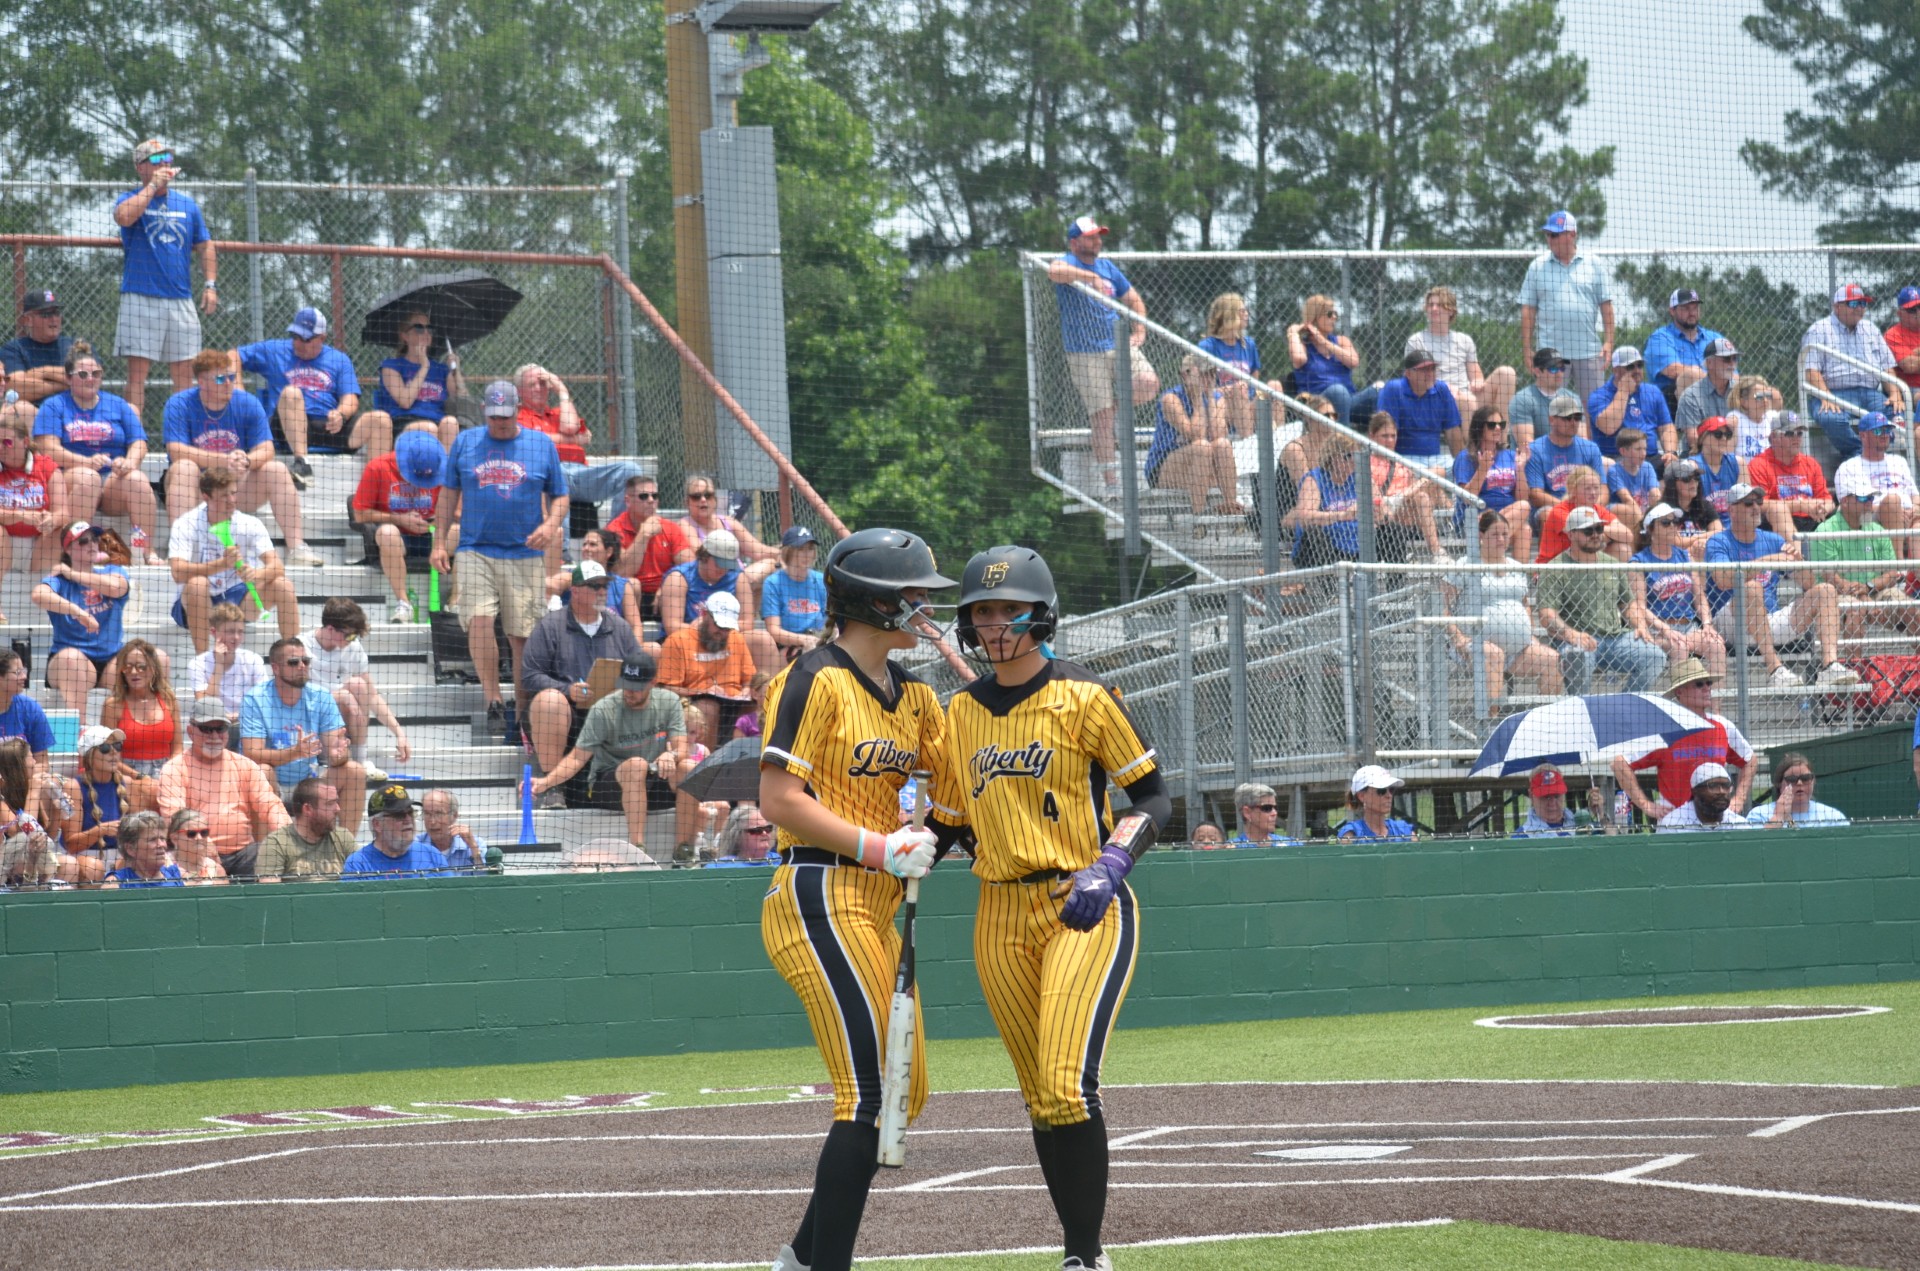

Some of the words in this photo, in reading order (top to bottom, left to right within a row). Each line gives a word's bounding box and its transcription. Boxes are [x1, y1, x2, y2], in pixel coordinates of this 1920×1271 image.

[848, 738, 918, 778] Liber
[968, 740, 1055, 799] Liberty
[1043, 791, 1060, 823] 4
